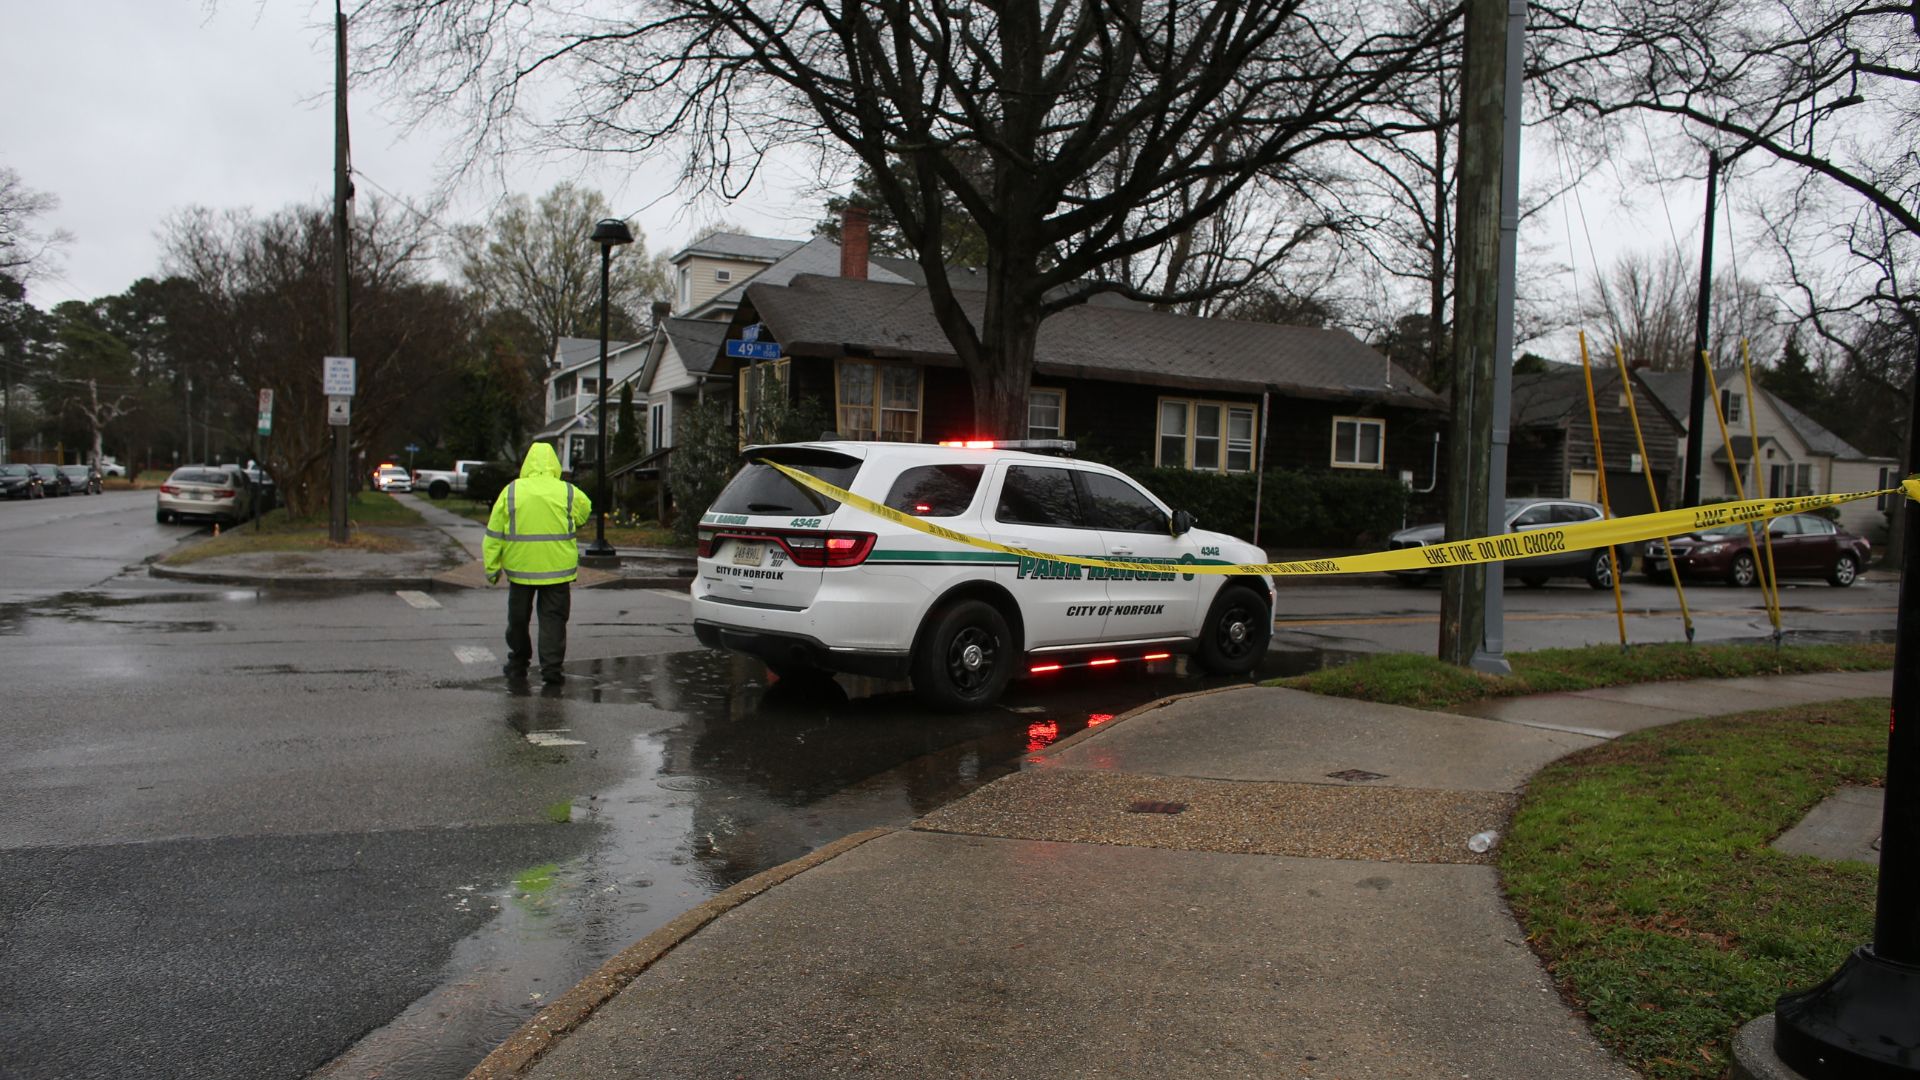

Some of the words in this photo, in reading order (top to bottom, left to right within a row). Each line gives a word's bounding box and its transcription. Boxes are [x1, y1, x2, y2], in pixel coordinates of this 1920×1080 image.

[791, 518, 821, 528] 4342
[1201, 546, 1220, 556] 4342
[716, 566, 731, 576] CITY
[732, 568, 742, 576] OF
[743, 569, 784, 580] NORFOLK
[1066, 605, 1096, 616] CITY
[1098, 605, 1113, 616] OF
[1114, 604, 1164, 616] NORFOLK
